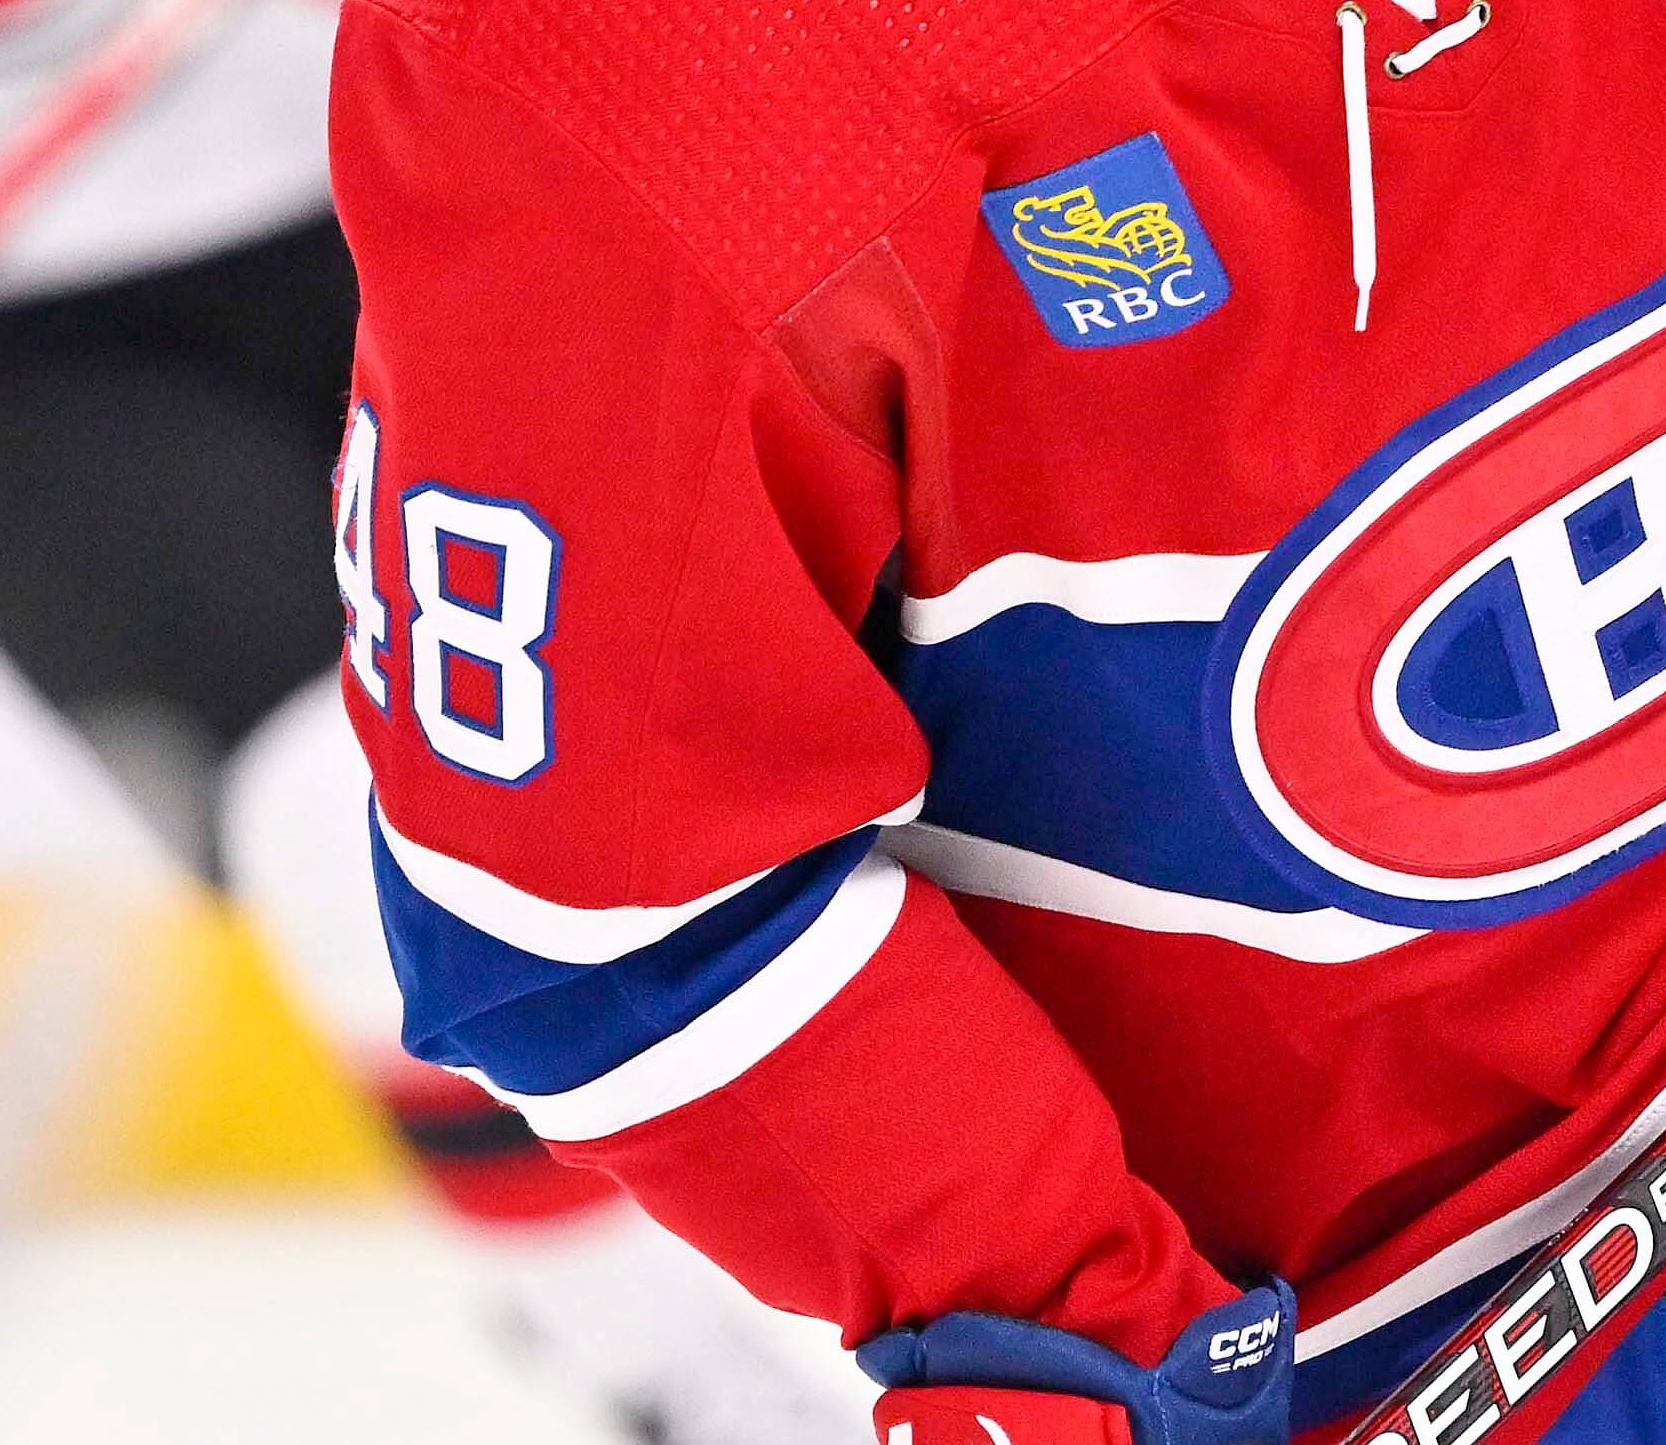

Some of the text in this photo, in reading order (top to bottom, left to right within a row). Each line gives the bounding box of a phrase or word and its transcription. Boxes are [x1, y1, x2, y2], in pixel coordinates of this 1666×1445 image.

[1062, 268, 1205, 335] RBC
[332, 398, 564, 789] 48
[1209, 1310, 1280, 1360] CCM
